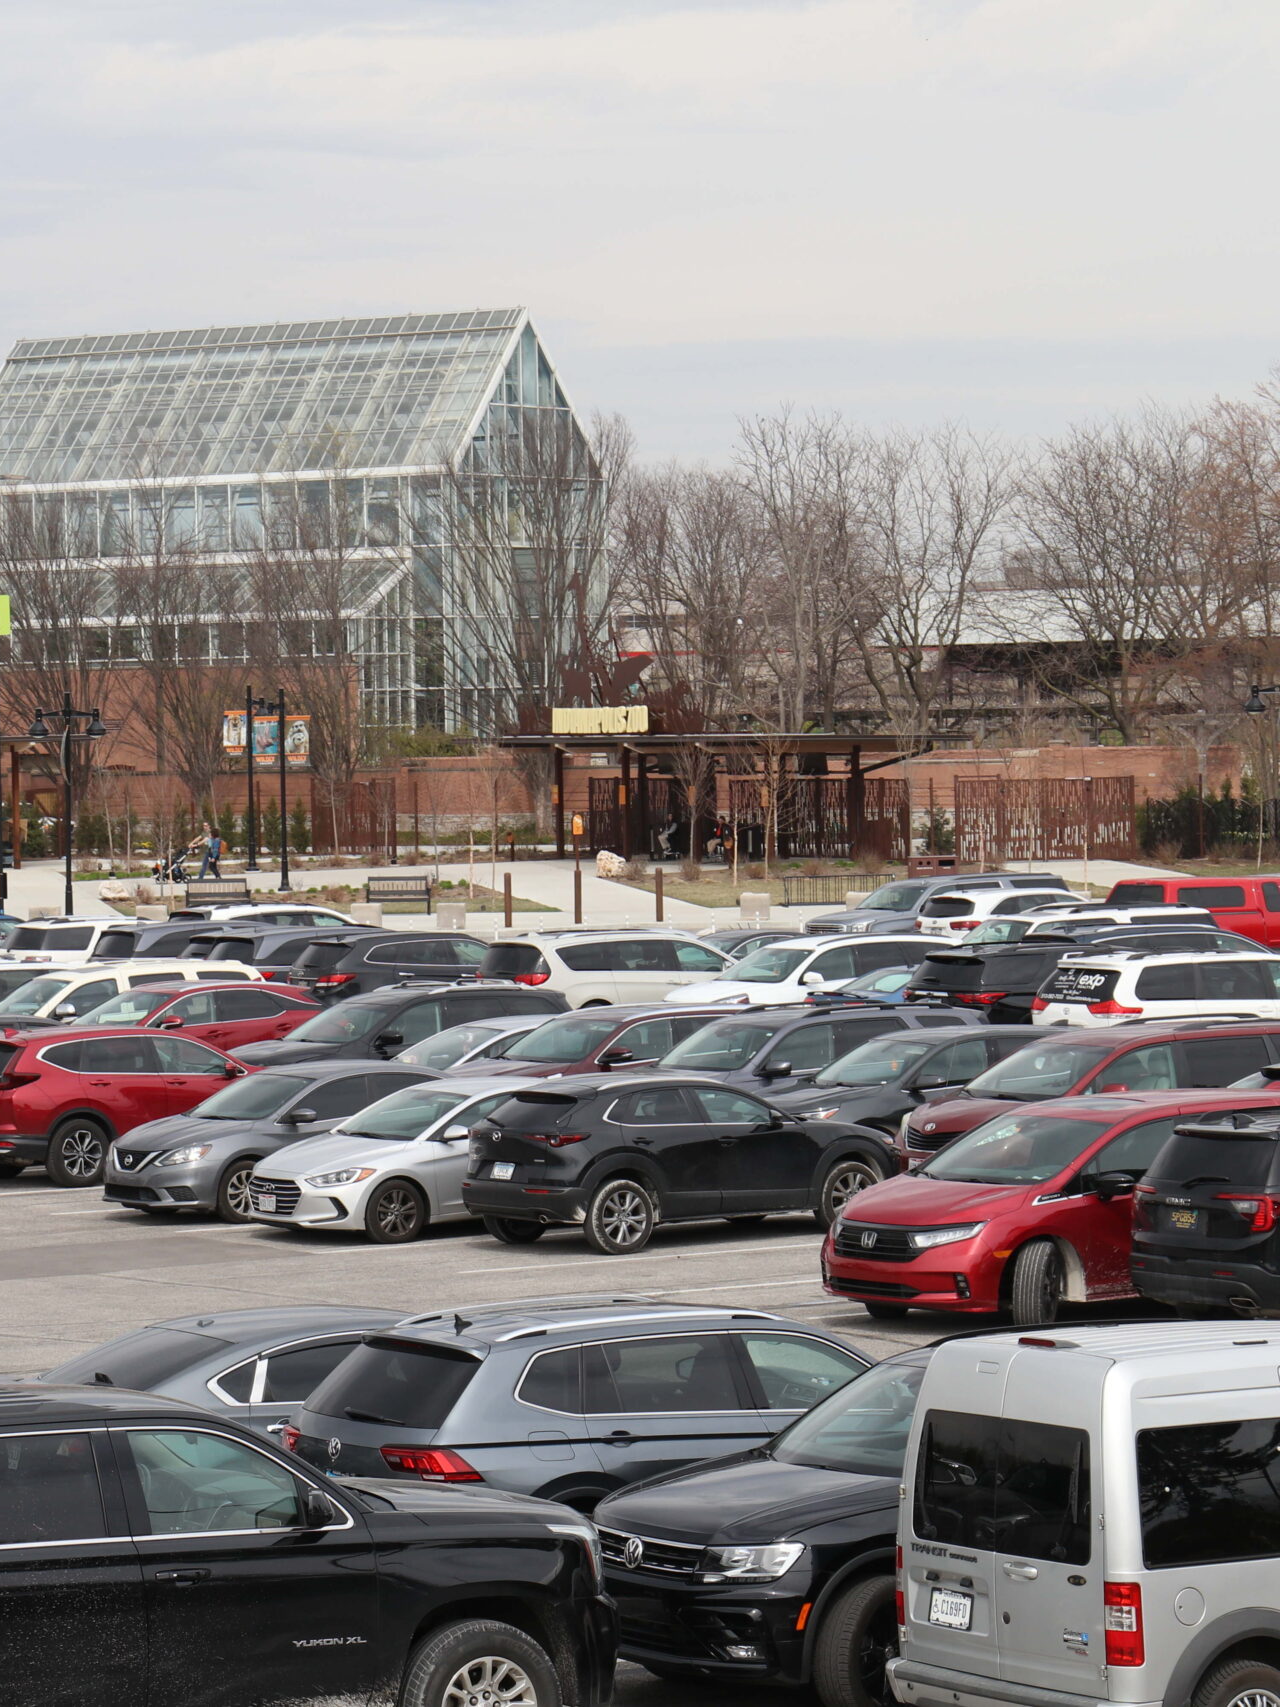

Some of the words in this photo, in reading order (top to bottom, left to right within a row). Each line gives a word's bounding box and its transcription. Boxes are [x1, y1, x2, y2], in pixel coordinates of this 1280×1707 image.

[1079, 973, 1106, 990] exp
[940, 1599, 968, 1619] C169FD
[292, 1637, 344, 1648] YUKON
[345, 1636, 367, 1645] XL
